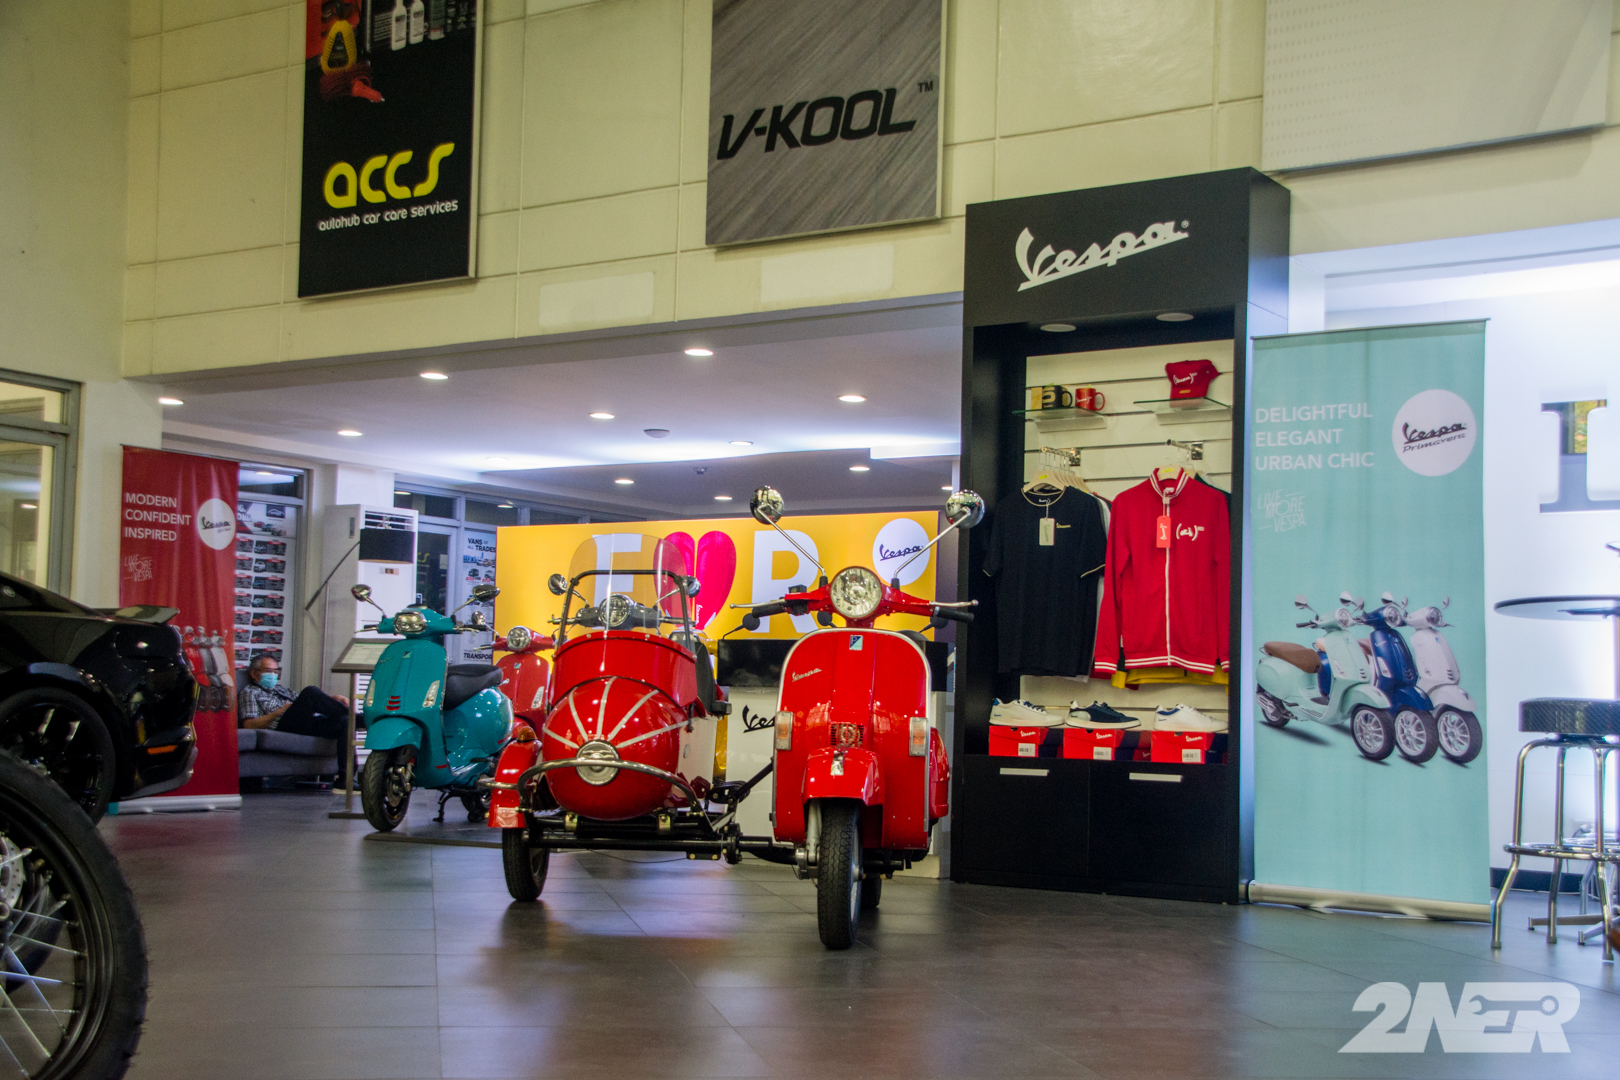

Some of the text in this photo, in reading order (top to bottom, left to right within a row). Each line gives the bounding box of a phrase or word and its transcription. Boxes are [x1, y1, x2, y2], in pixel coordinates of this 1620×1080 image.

[716, 87, 917, 160] V-KOOL
[324, 142, 455, 209] accs
[318, 200, 459, 231] autohub car care services
[1015, 220, 1189, 292] Vespa
[1255, 403, 1373, 423] DELIGHTFUL
[1255, 428, 1343, 447] ELEGANT
[1402, 422, 1467, 445] Vespa
[1255, 452, 1374, 471] URBAN CHIC
[125, 493, 178, 508] MODERN
[125, 509, 191, 525] CONFIDENT
[1274, 512, 1305, 532] VESPA
[125, 527, 177, 541] INSPIRED
[879, 544, 924, 561] Vespa
[742, 705, 775, 733] Ves
